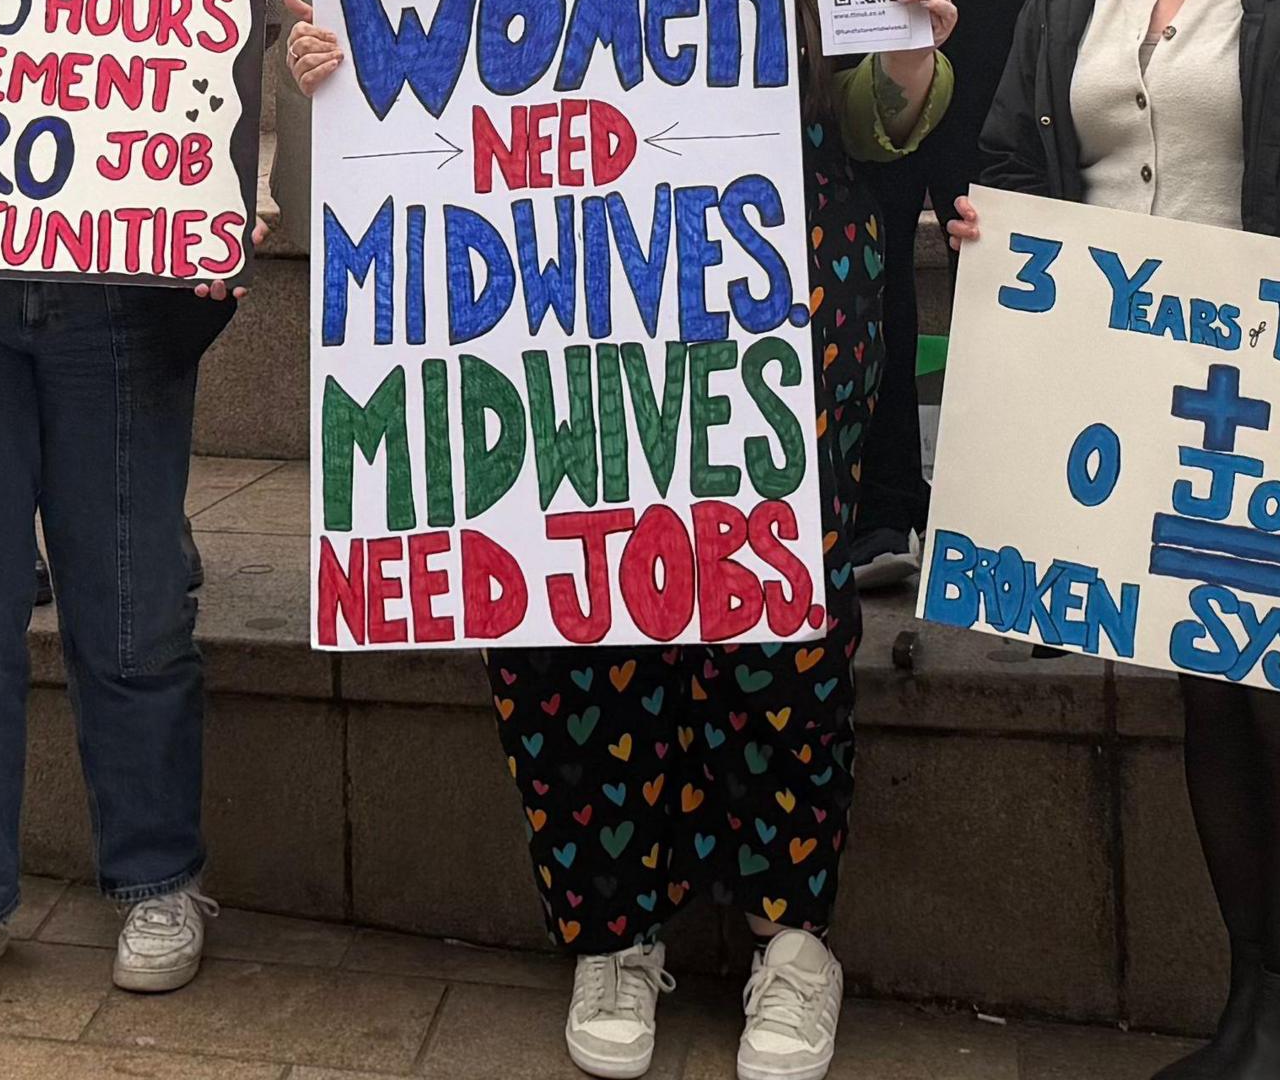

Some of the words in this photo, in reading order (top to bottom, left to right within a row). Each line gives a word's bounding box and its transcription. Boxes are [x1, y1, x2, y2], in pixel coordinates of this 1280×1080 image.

[96, 130, 214, 185] JOB
[472, 99, 637, 193] NEED
[322, 174, 810, 346] MIDWIVES.
[998, 233, 1063, 313] 3
[1248, 321, 1267, 347] of
[322, 337, 807, 531] MIDWIVES
[1067, 422, 1120, 507] 0
[319, 529, 528, 646] NEED
[545, 498, 826, 643] JOBS.
[923, 529, 1140, 658] BROKEN
